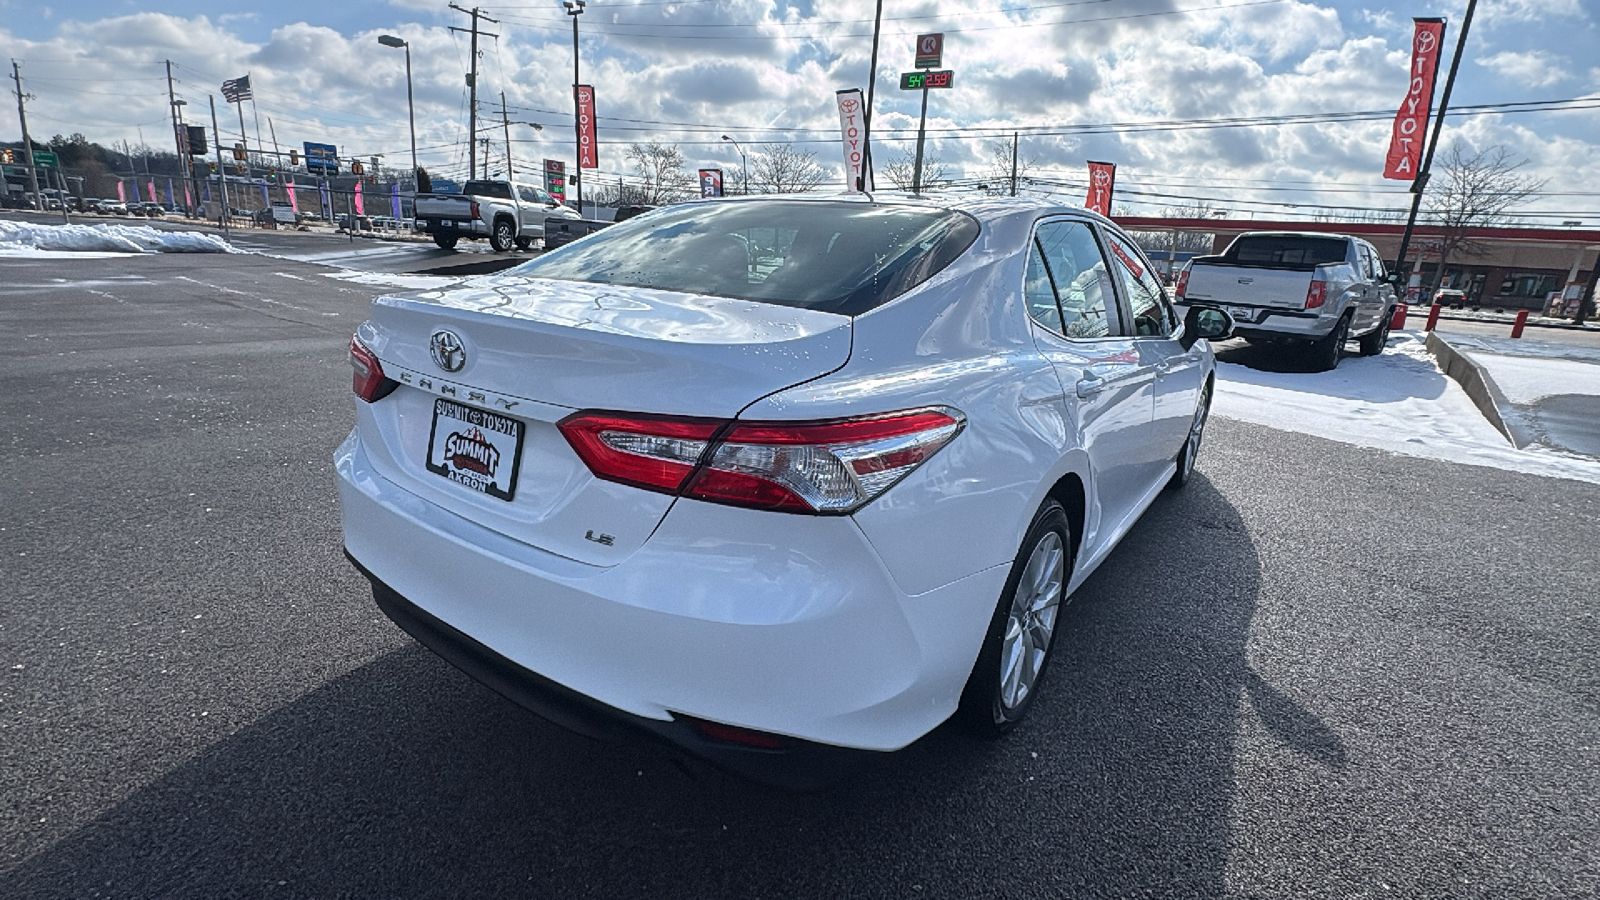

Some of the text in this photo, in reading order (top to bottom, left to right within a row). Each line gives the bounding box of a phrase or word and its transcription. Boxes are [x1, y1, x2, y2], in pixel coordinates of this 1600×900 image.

[579, 104, 591, 165] TOYOTA
[1395, 57, 1426, 173] TOYOTA
[846, 114, 861, 187] TOYOT
[399, 371, 519, 411] CAMRY
[436, 400, 518, 438] SUMMIT TOYOTA
[446, 434, 498, 475] SUMMIT
[447, 470, 486, 493] AKRON
[584, 529, 616, 547] LE
